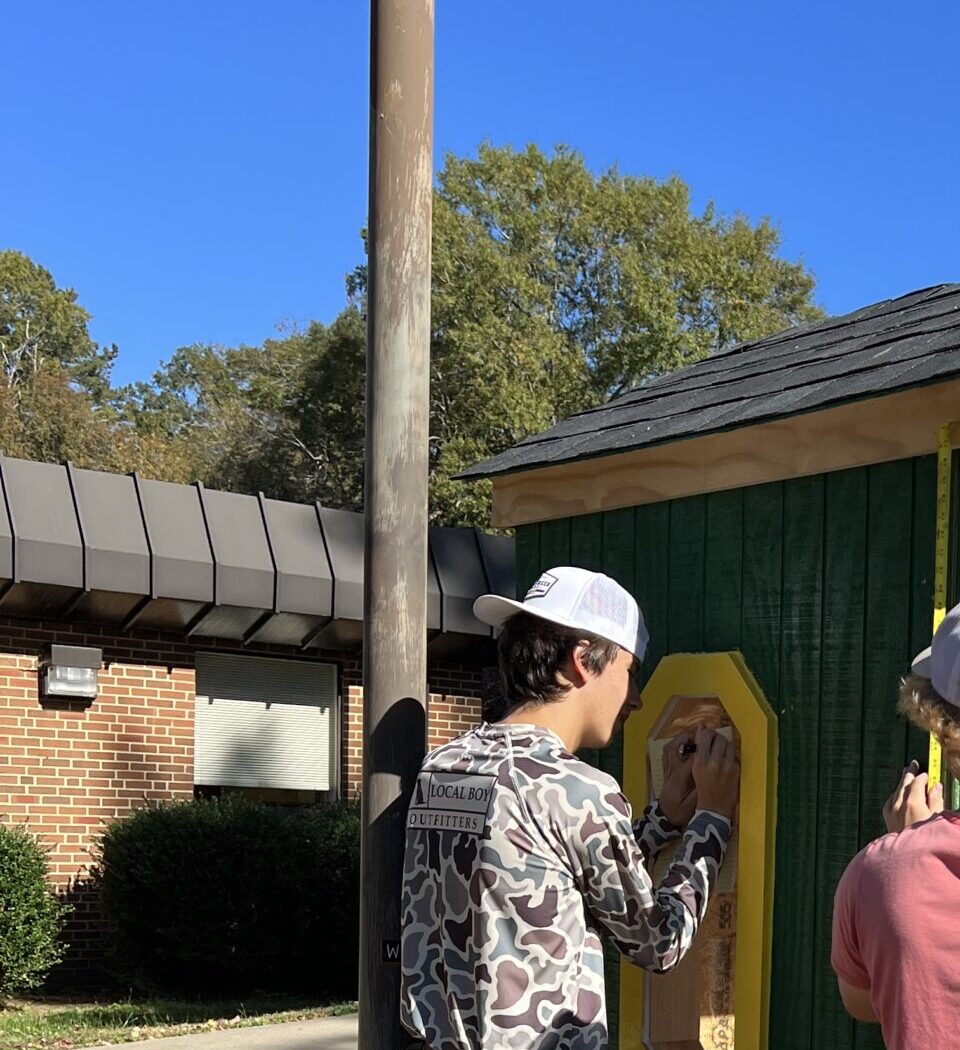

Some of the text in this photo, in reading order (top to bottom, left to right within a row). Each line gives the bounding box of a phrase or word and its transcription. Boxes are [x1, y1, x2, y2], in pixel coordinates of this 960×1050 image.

[431, 784, 492, 802] LOCAL BOY
[409, 813, 478, 830] OUTFITTERS
